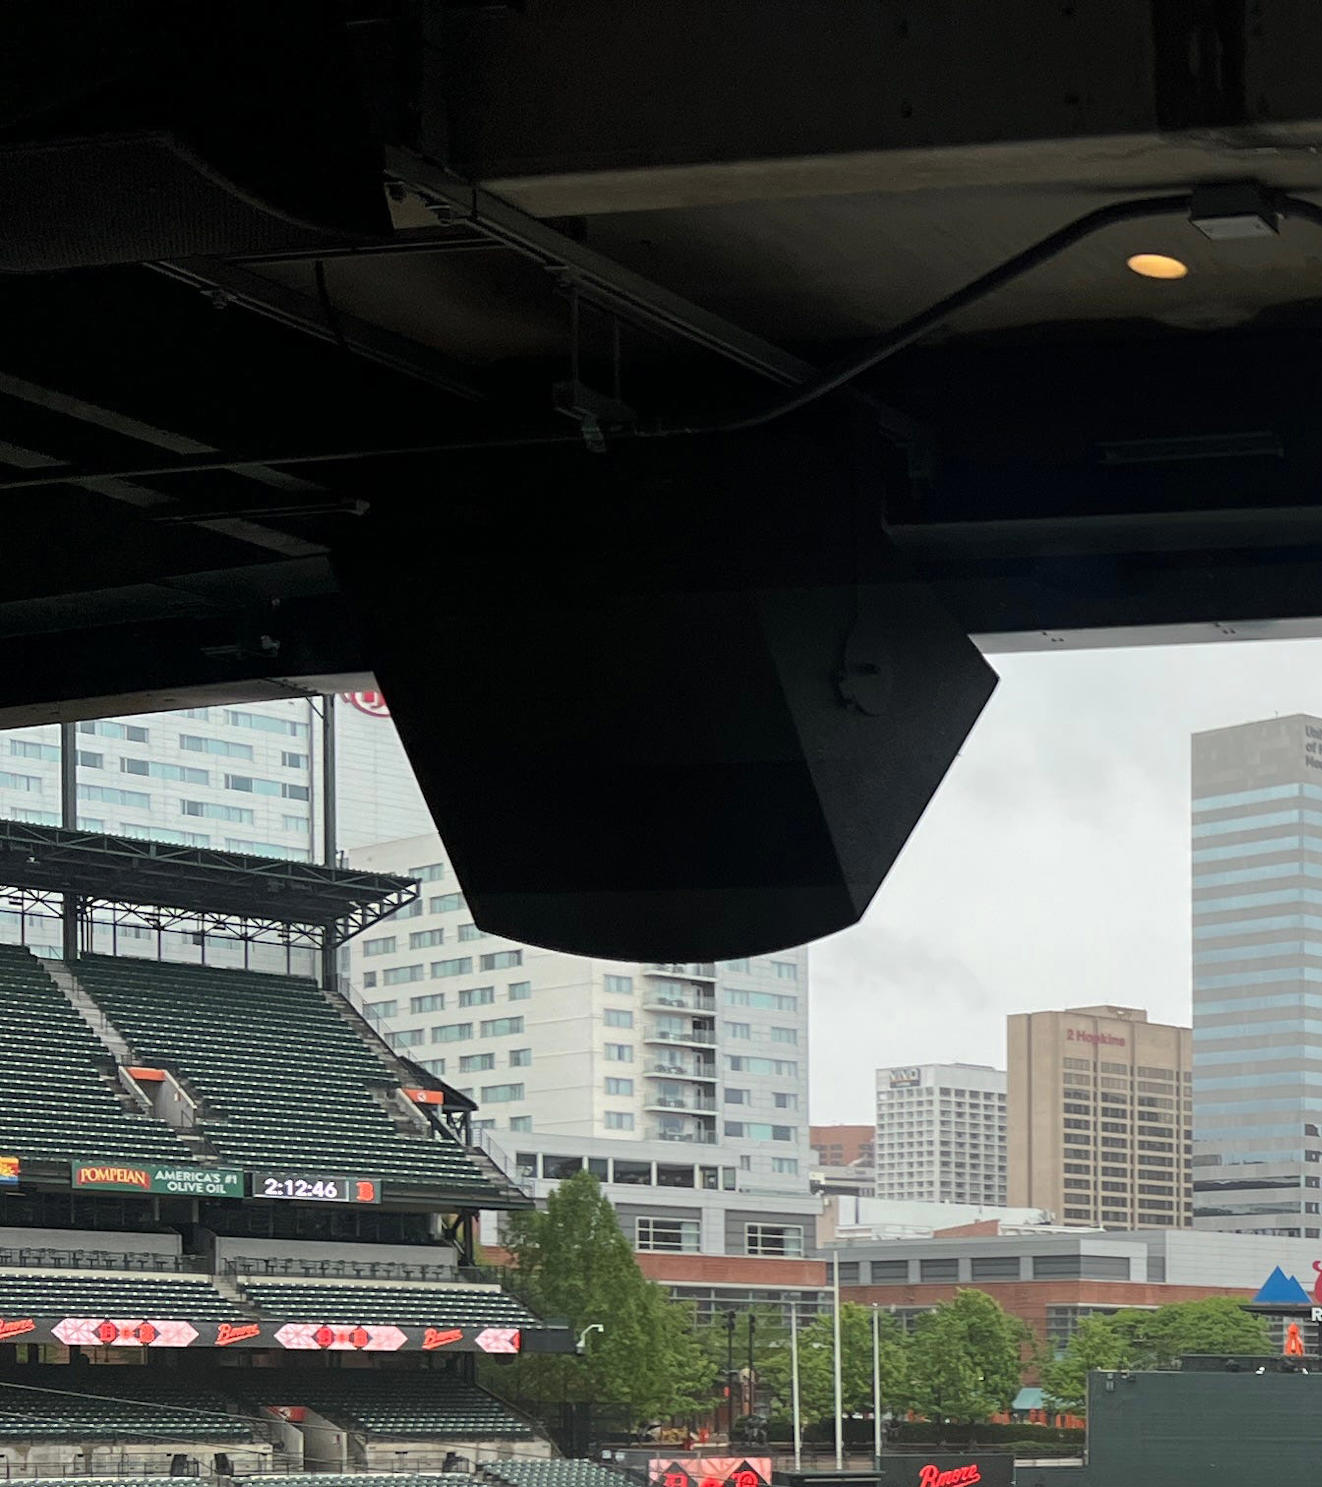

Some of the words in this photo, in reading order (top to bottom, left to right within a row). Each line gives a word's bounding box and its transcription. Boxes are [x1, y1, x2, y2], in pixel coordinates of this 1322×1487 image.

[80, 1166, 147, 1186] POMPEIAN
[155, 1169, 221, 1184] AMERICA'S
[224, 1171, 238, 1184] #1
[167, 1180, 203, 1193] OLIVE
[204, 1182, 226, 1195] OIL
[263, 1176, 338, 1199] 2:12:46
